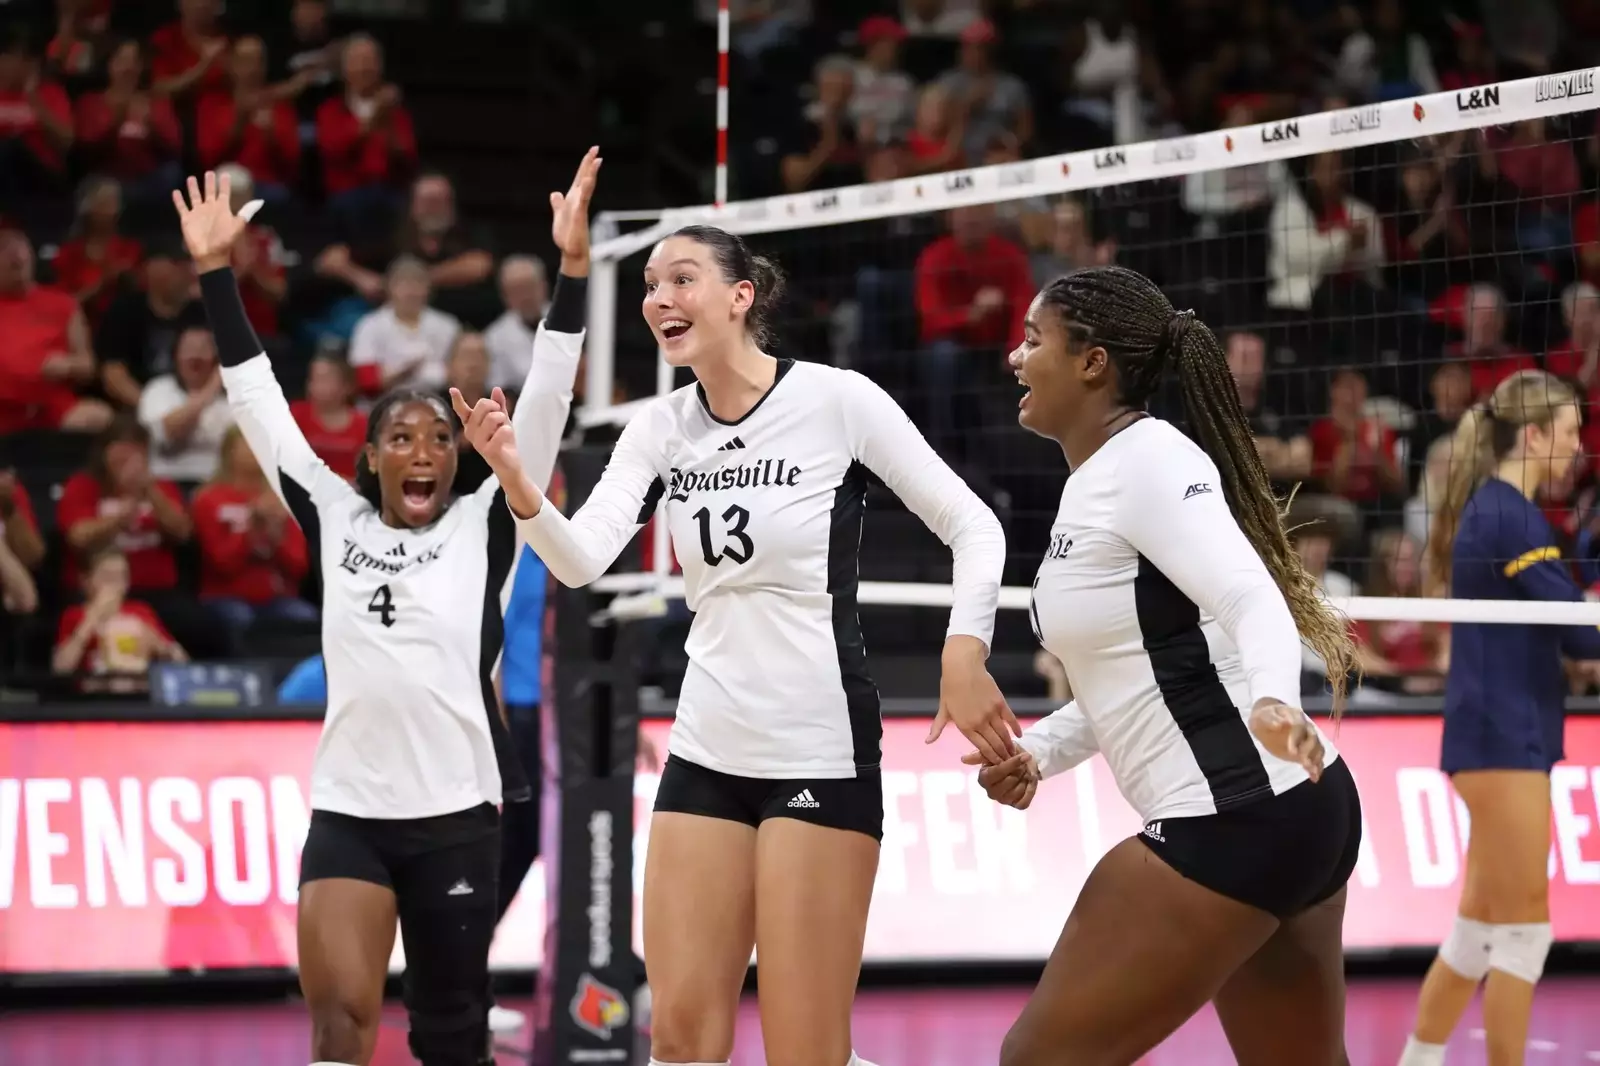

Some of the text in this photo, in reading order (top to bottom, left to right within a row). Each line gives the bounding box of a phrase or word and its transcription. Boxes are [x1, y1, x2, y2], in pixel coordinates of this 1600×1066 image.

[1456, 86, 1500, 112] L&N
[1535, 72, 1594, 103] LOUISVILLE
[1261, 121, 1300, 143] L&N
[668, 458, 803, 503] Louisville
[1184, 483, 1212, 498] ACC
[692, 503, 755, 567] 13
[368, 584, 396, 628] 4
[787, 800, 820, 808] adidas
